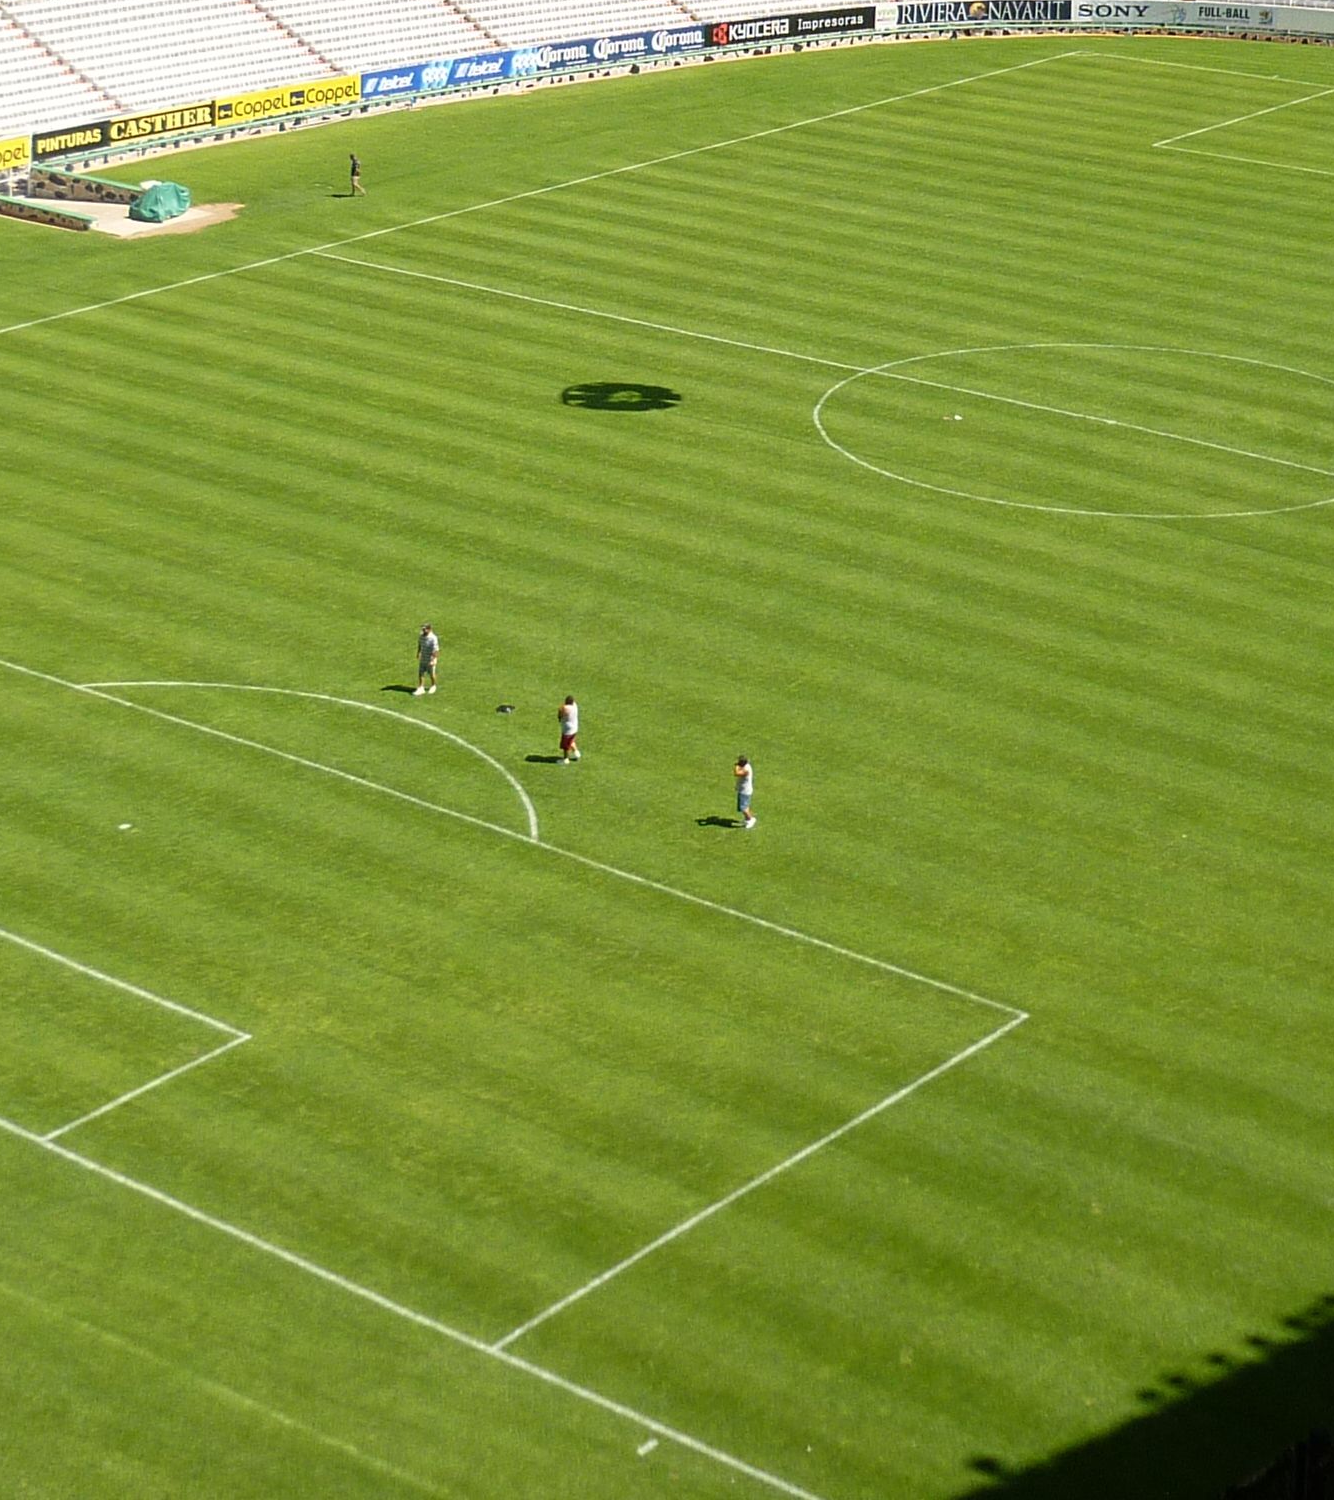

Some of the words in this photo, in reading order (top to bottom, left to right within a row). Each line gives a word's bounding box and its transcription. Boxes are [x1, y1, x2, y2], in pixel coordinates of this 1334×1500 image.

[902, 1, 968, 23] RIVIERA
[987, 0, 1064, 21] NAYARIT
[1078, 3, 1150, 18] SONY
[1198, 6, 1250, 20] FULL-BALL
[728, 17, 790, 42] KYOCERA
[797, 14, 865, 33] Impresoras
[593, 37, 648, 60] Corona
[652, 30, 705, 53] Corona
[538, 44, 590, 67] Corona
[306, 81, 360, 104] Coppel
[233, 93, 288, 117] Coppel
[37, 128, 102, 155] PINTURAS
[110, 105, 213, 141] CASTHER
